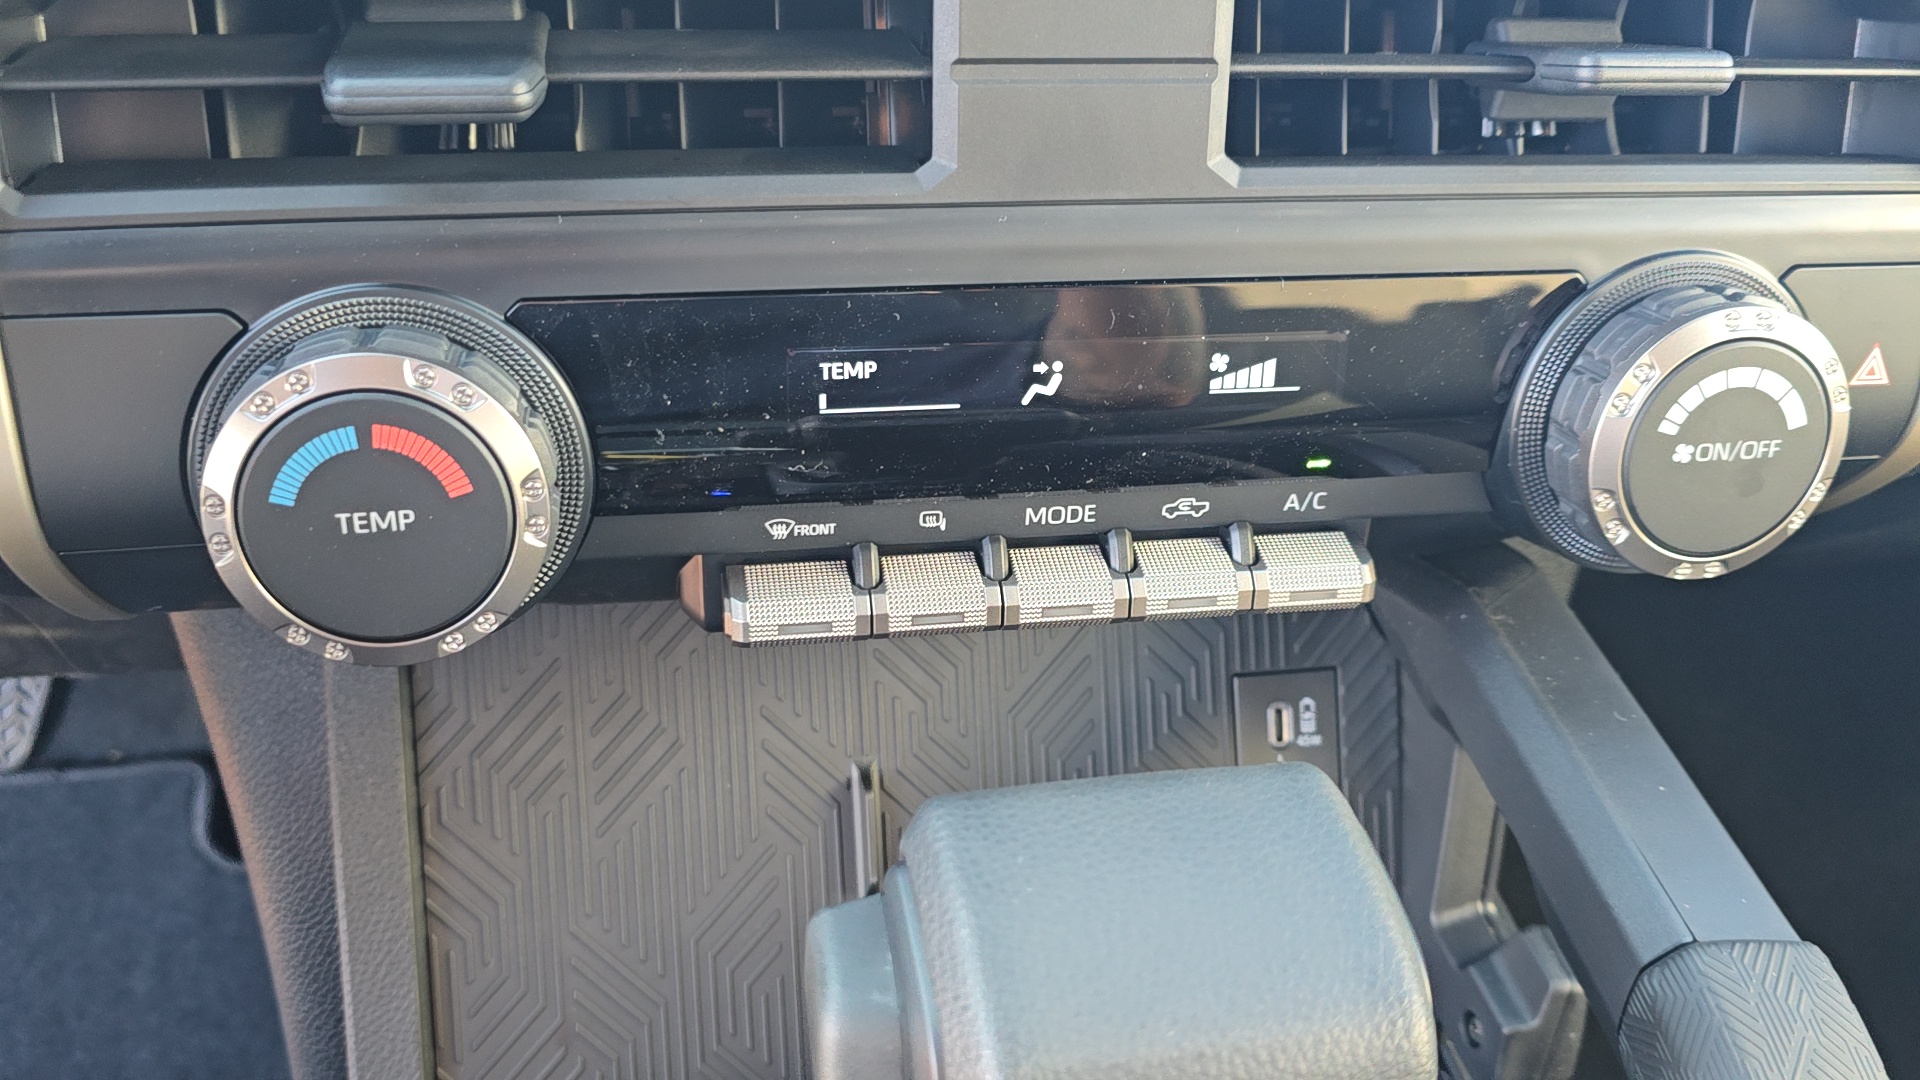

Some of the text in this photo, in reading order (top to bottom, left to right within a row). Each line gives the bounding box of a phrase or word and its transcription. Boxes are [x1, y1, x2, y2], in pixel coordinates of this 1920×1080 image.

[819, 361, 878, 381] TEMP
[1695, 439, 1783, 462] ON/OFF
[1282, 491, 1328, 512] A/C
[334, 509, 416, 535] TEMP
[1025, 504, 1097, 526] MODE
[794, 522, 837, 537] FRONT
